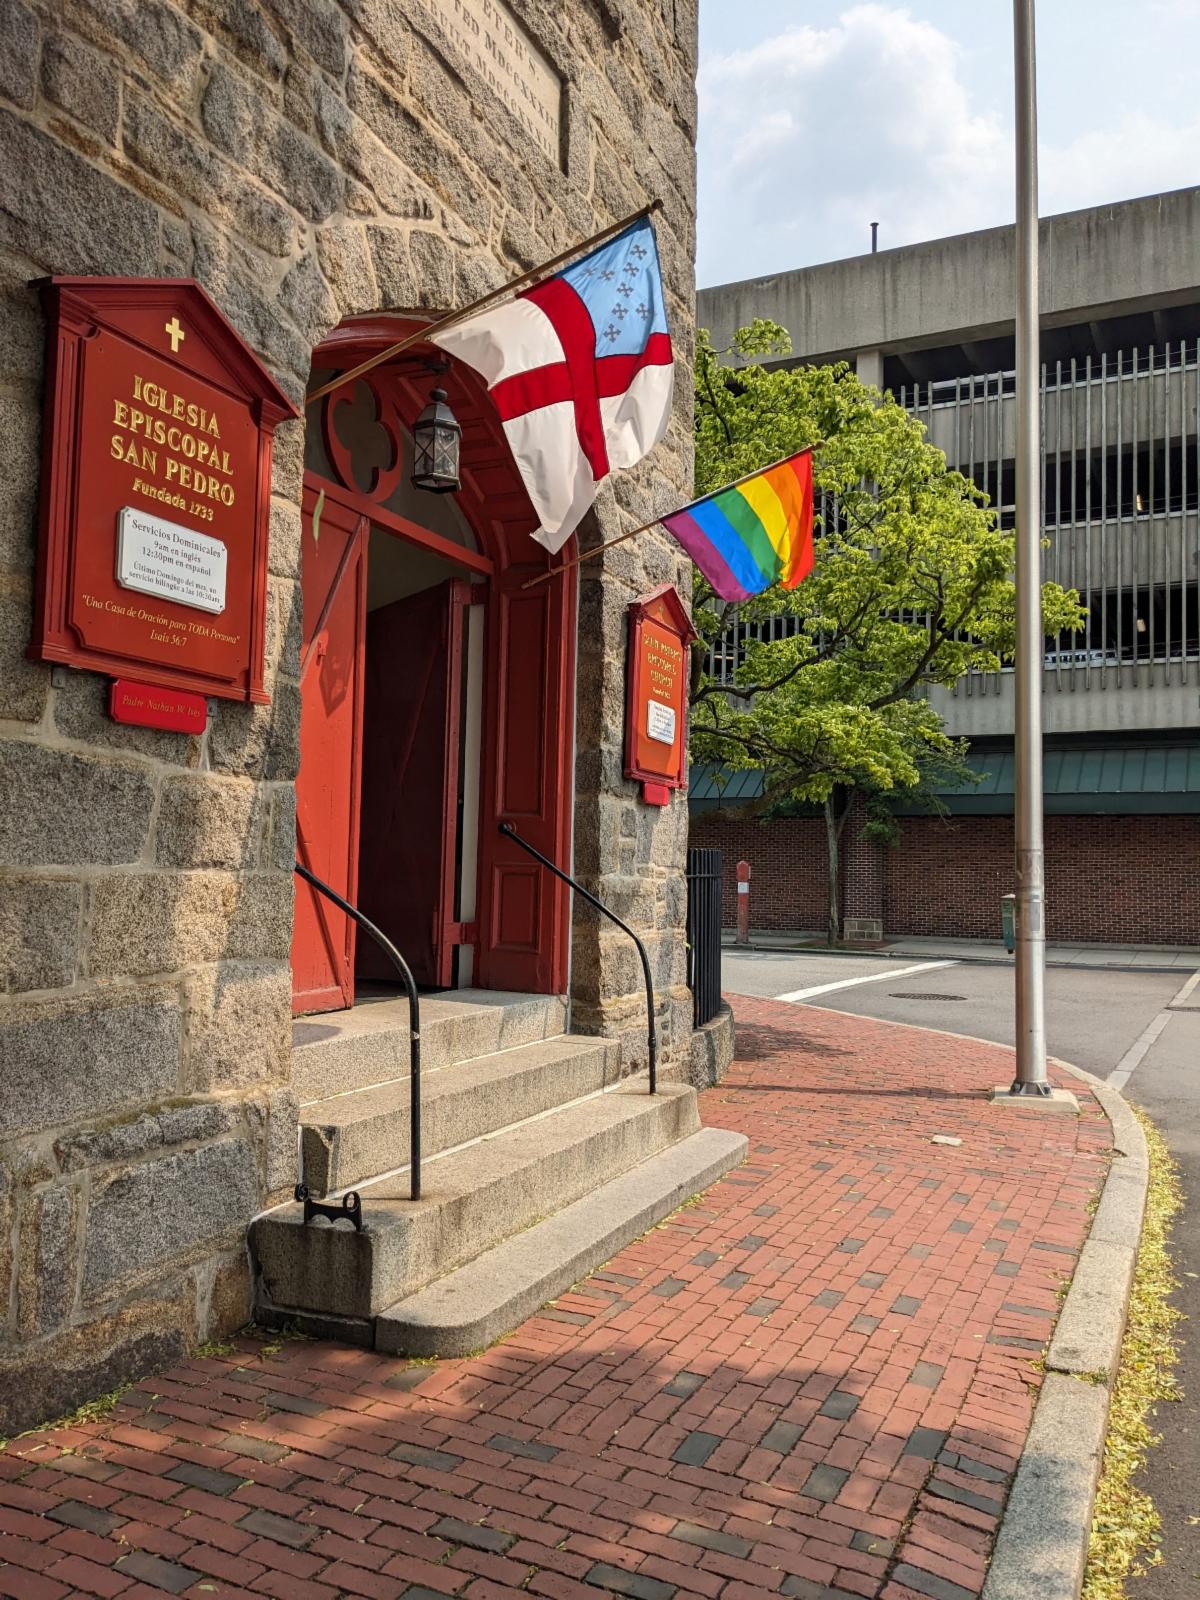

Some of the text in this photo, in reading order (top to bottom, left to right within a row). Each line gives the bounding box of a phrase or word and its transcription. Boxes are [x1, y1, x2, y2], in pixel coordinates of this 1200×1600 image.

[132, 374, 221, 439] IGLESIA
[112, 399, 234, 476] EPISCOPAL
[110, 434, 235, 506] SAN PEDRO
[131, 477, 214, 522] Fundada 1733
[131, 519, 221, 558] Servicios Dominicales
[153, 540, 202, 563] 9am en inglés
[128, 570, 154, 583] servicio
[133, 560, 156, 576] Último
[156, 569, 185, 585] Domingo
[185, 577, 195, 588] del
[141, 546, 212, 577] 12:30pm en español
[81, 593, 241, 645] "Una Casa de Oración para TODA Persona"
[170, 633, 188, 648] 56:7
[121, 694, 144, 709] Padre
[146, 696, 174, 713] Nathan
[187, 704, 201, 718] Ives
